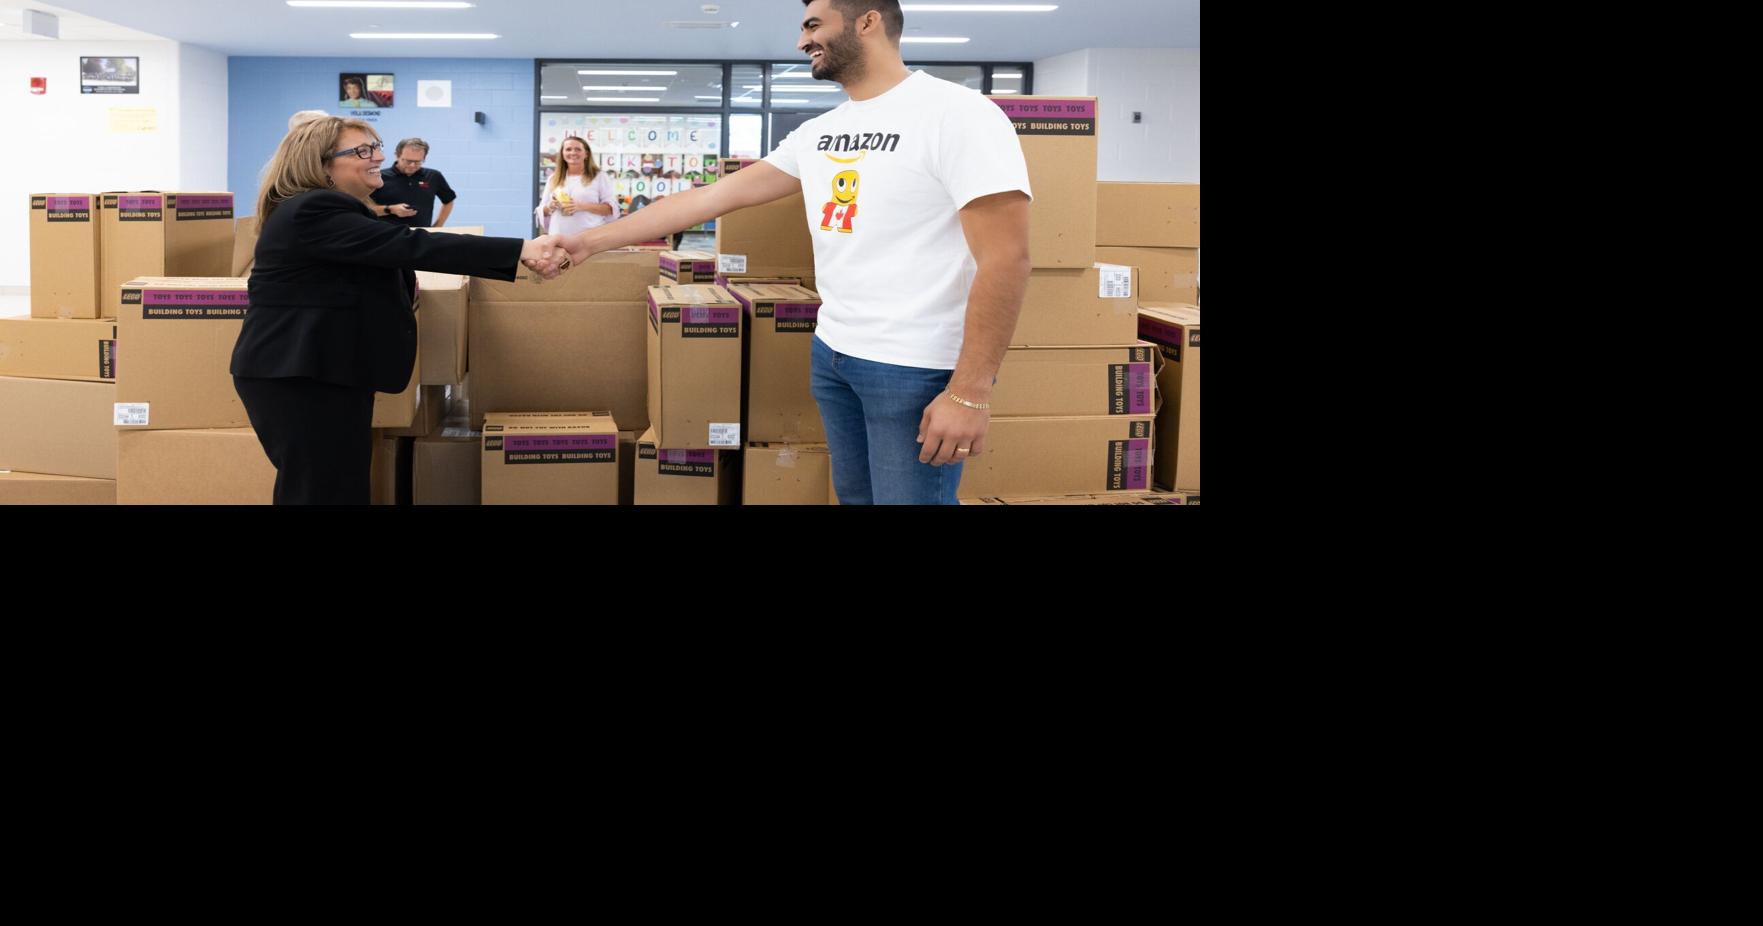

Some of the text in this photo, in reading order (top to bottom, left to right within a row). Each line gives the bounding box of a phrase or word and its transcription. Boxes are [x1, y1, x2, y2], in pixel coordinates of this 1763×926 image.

[1030, 122, 1068, 130] BUILDING
[817, 132, 900, 152] amazon
[1115, 365, 1124, 414] BUILDING TOYS
[660, 464, 712, 473] BUILDING TOYS
[1113, 441, 1122, 489] BUILDING TOYS
